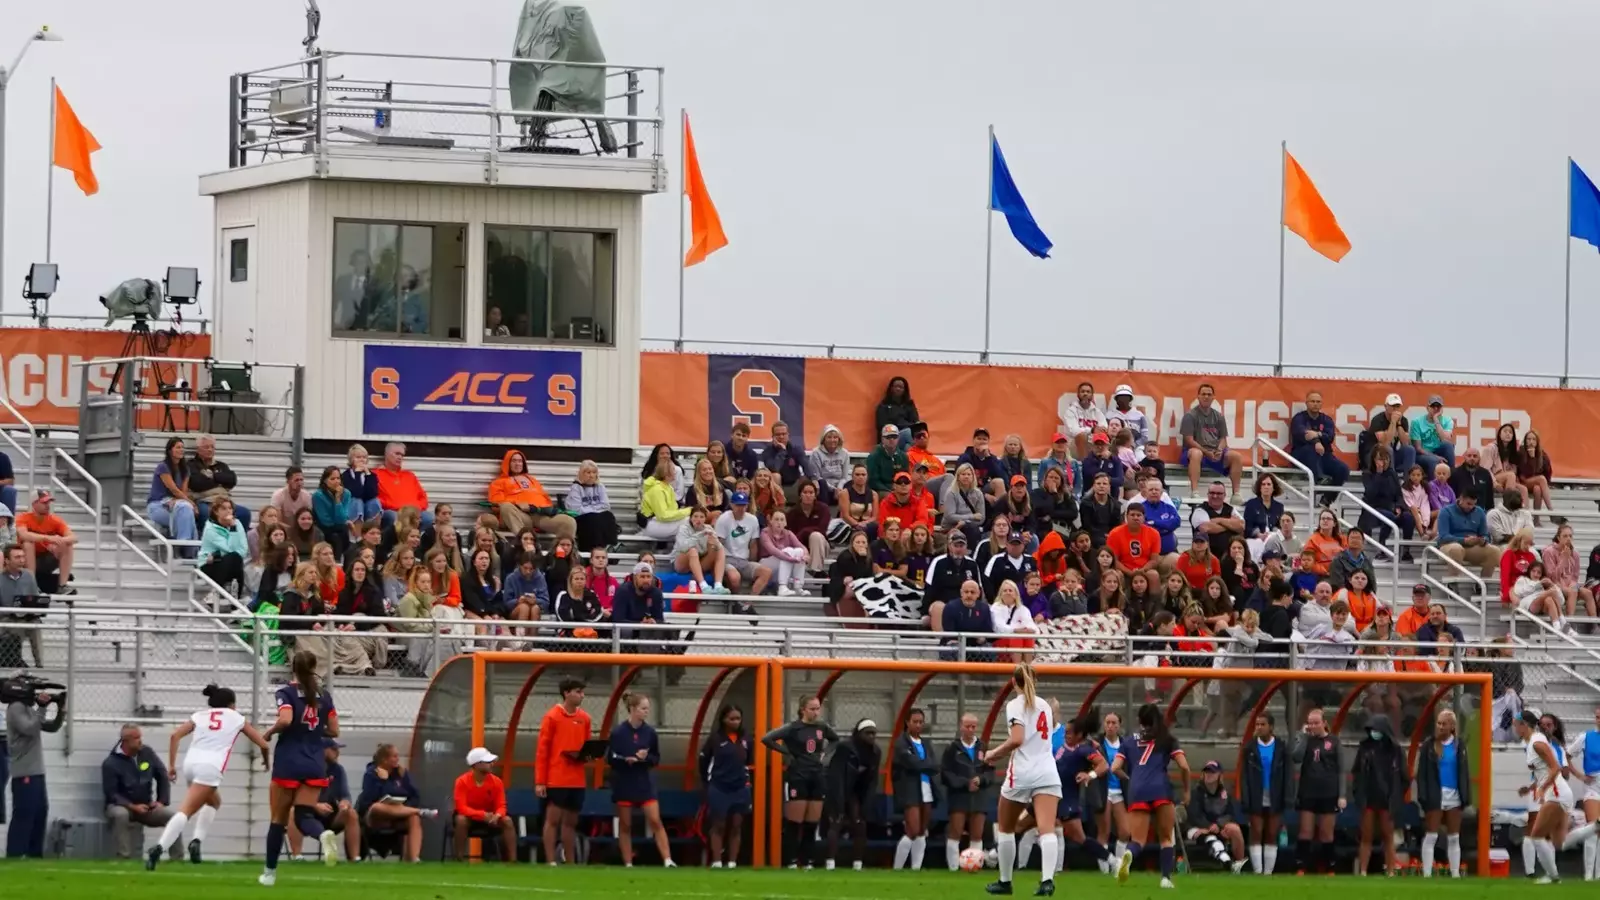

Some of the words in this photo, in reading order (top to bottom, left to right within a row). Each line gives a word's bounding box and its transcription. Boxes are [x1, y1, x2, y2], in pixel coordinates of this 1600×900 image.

[0, 353, 152, 410] CUSE
[370, 367, 400, 410] S
[423, 371, 535, 404] ACC
[547, 374, 576, 415] S
[732, 368, 781, 442] S
[1129, 539, 1142, 558] S
[208, 711, 224, 731] 5
[301, 704, 320, 731] 4
[1036, 711, 1049, 740] 4
[806, 739, 816, 753] 0
[1136, 738, 1156, 766] 7
